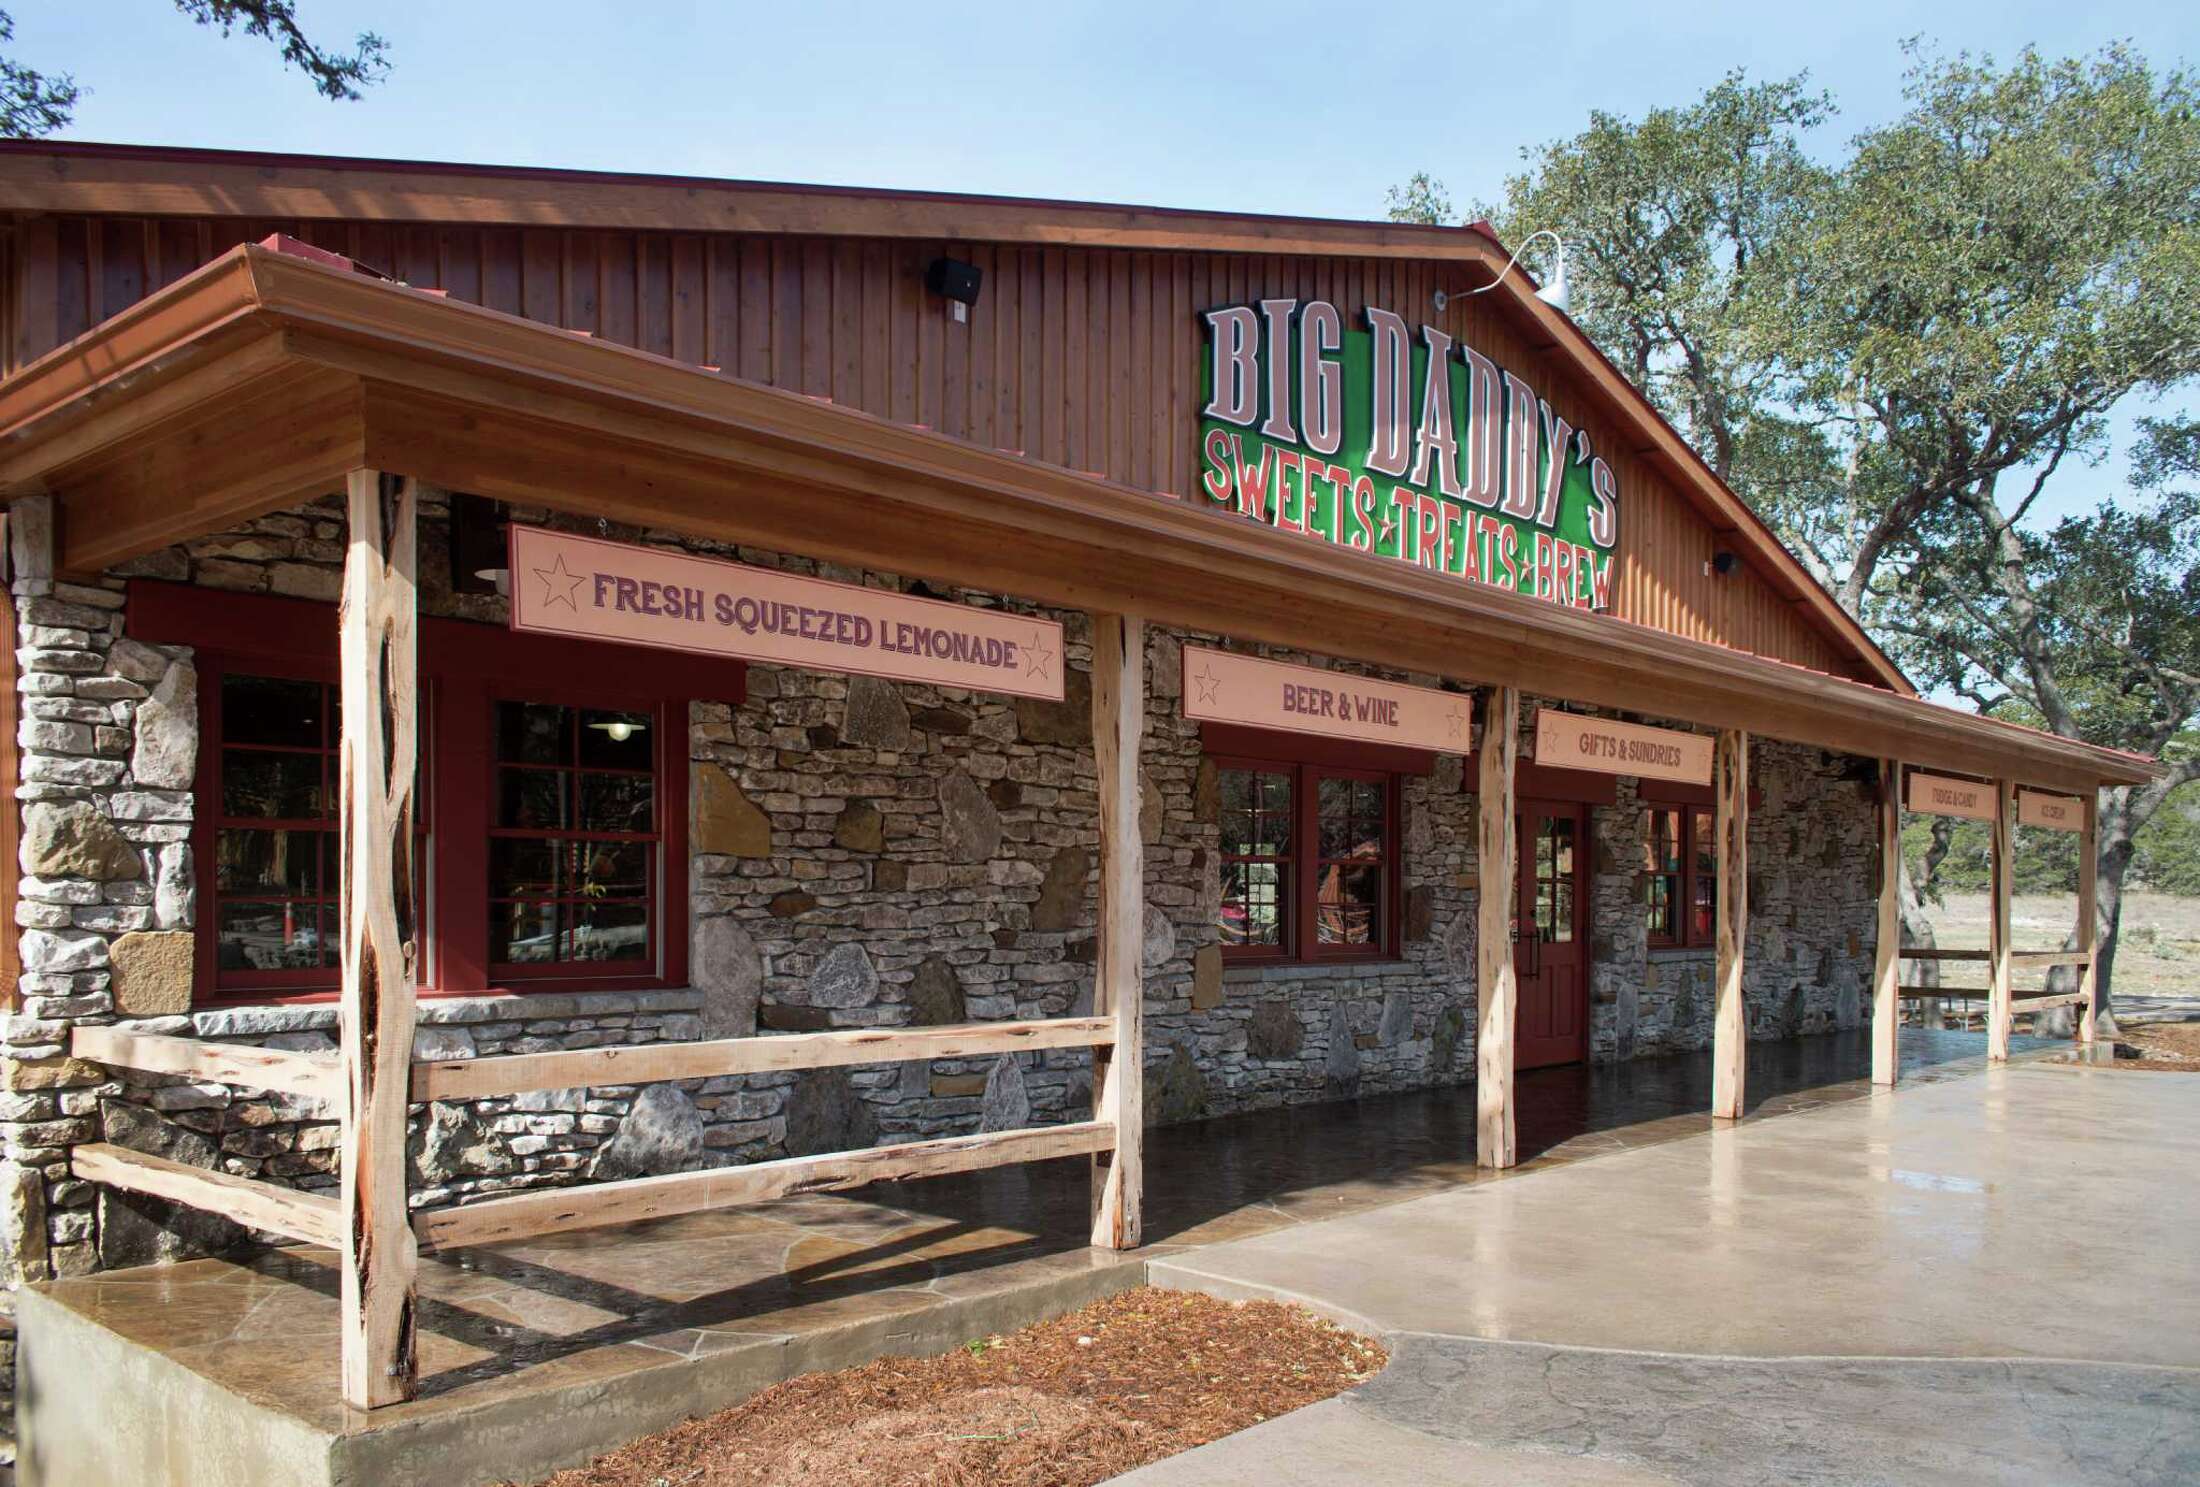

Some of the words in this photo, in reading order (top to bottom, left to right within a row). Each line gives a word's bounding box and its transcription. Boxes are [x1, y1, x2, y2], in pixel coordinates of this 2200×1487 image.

[1203, 299, 1342, 455] BIG
[1364, 306, 1618, 548] DADDY'S
[1204, 428, 1377, 555] SWEETS
[1390, 486, 1519, 593] TREATS
[1534, 532, 1615, 611] BREW
[593, 572, 705, 622] FRESH
[714, 592, 873, 648] SQUEEZED
[879, 620, 1019, 669] LEMONADE
[1282, 683, 1334, 718] BEER
[1338, 692, 1352, 721] &
[1353, 694, 1399, 727] WINE
[1580, 733, 1616, 757] GIFTS
[1618, 739, 1628, 761] &
[1628, 740, 1681, 767] SUNDRIES
